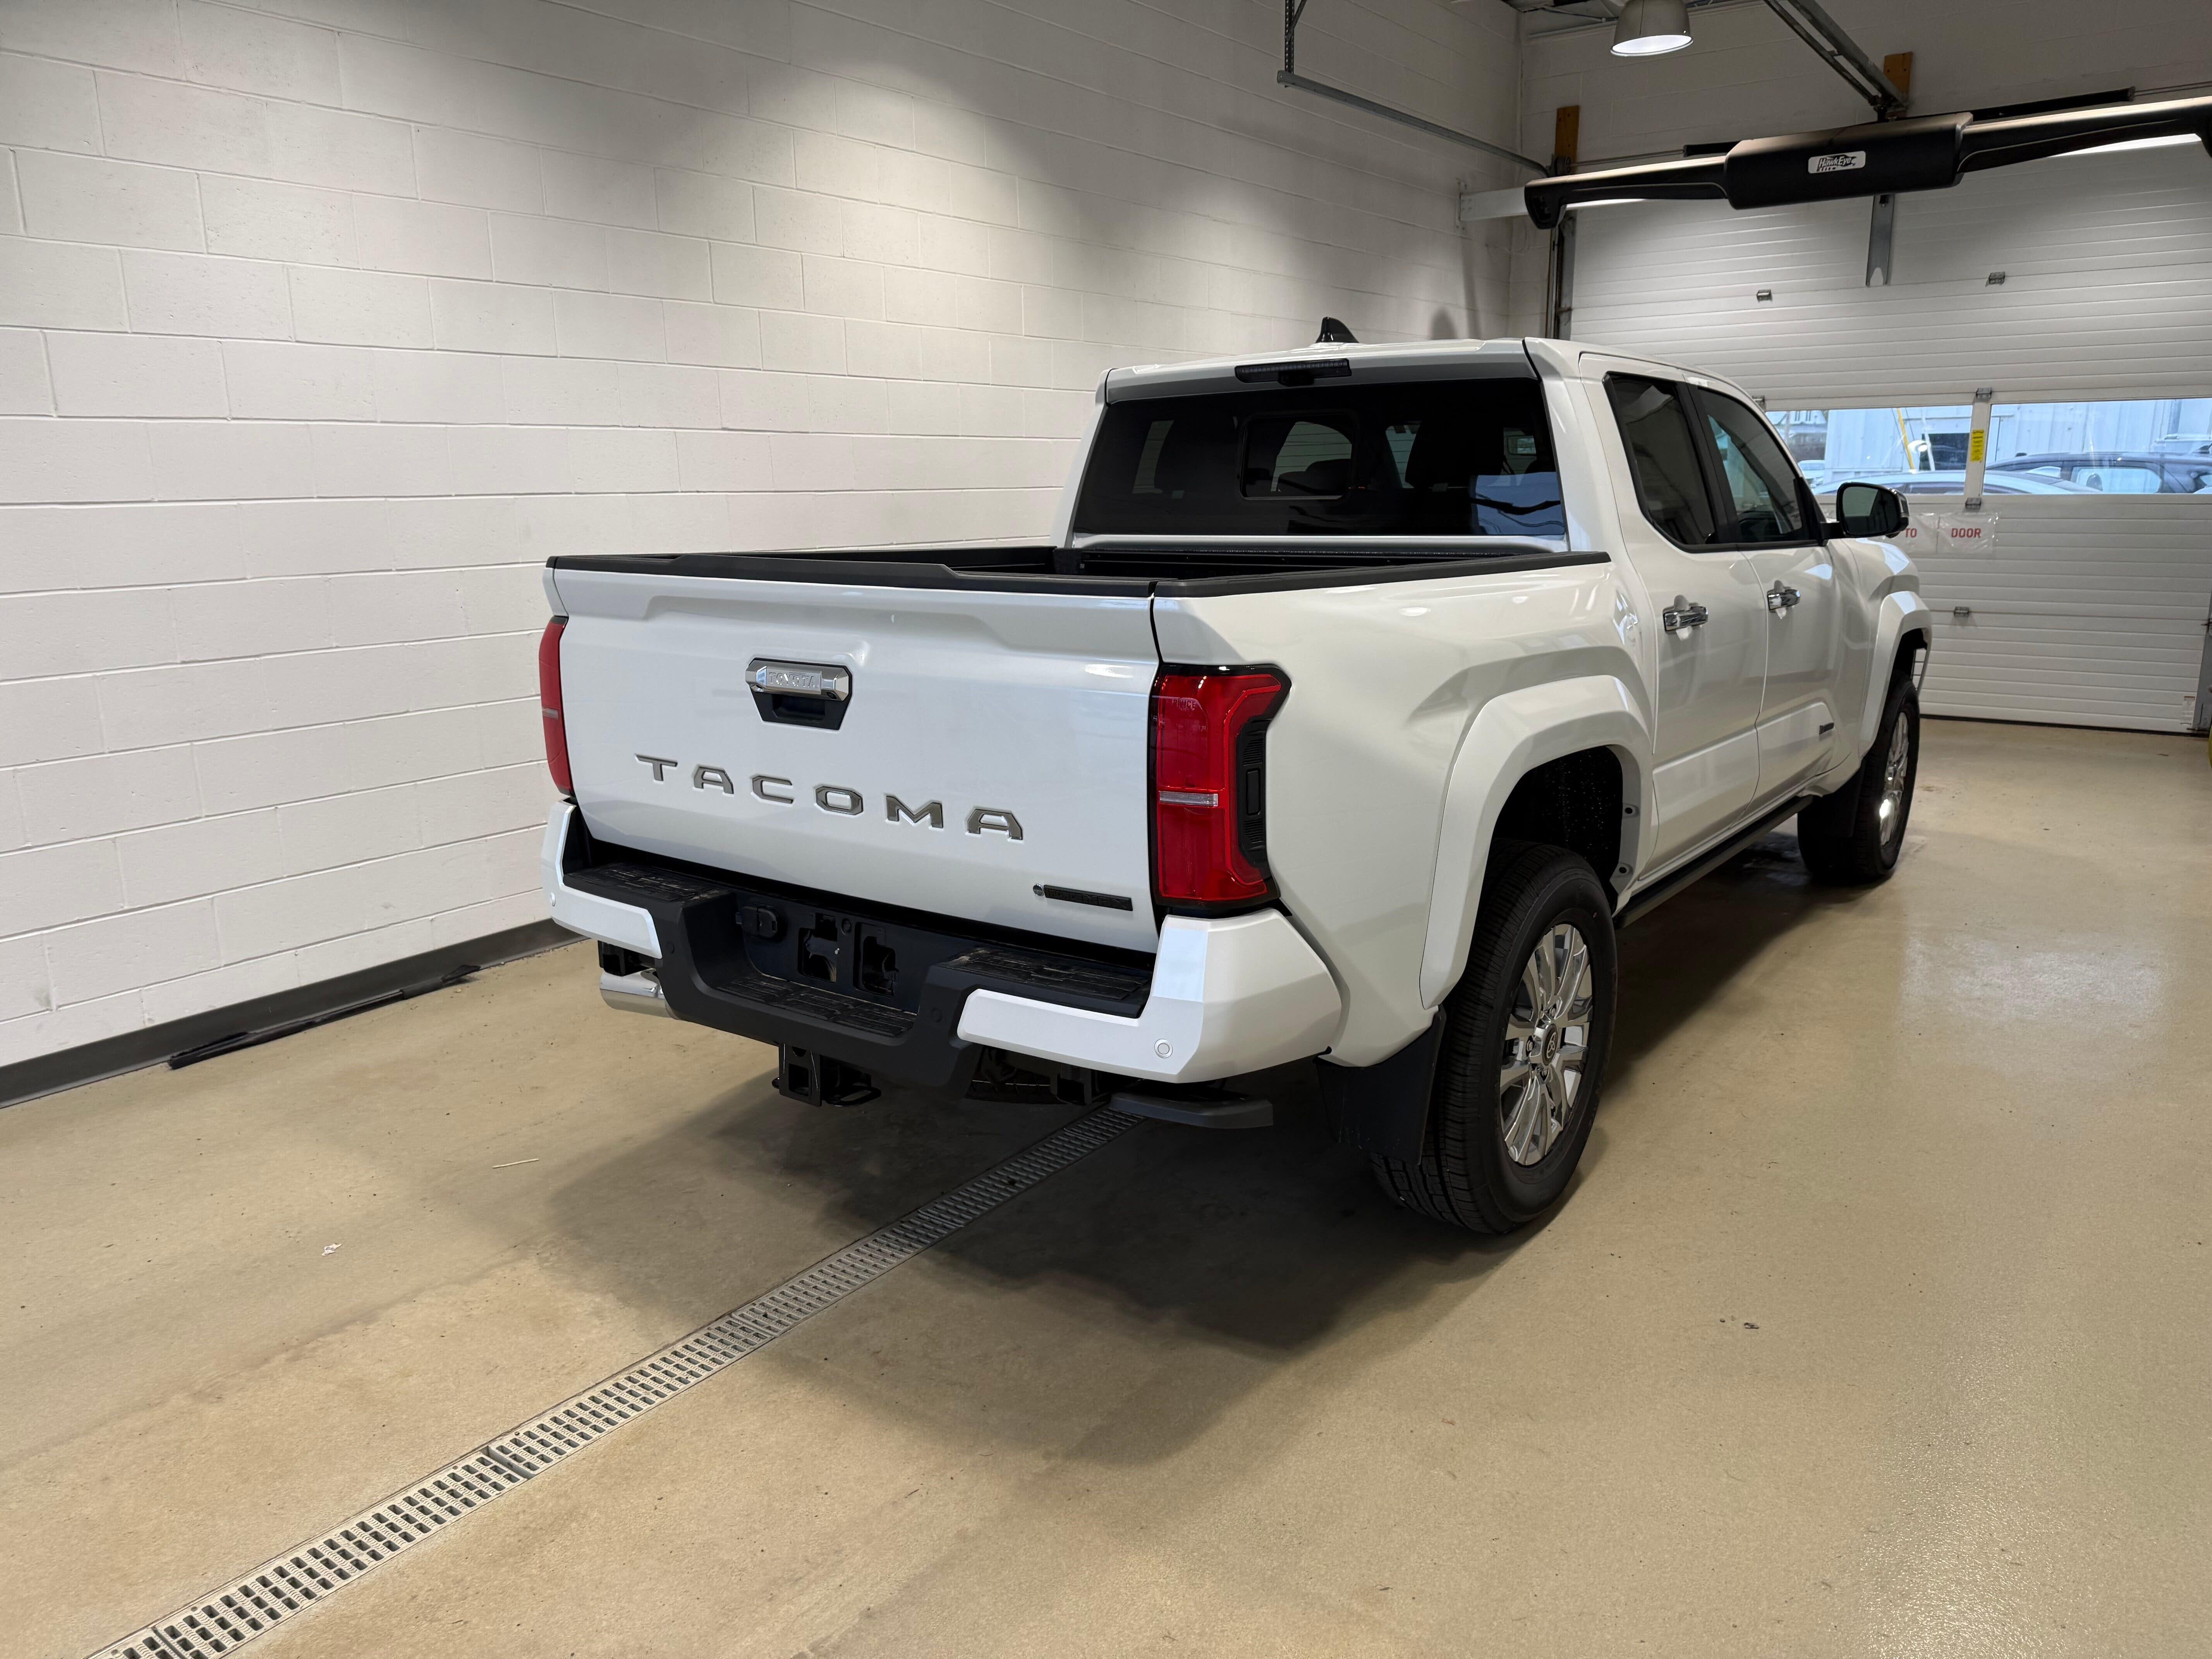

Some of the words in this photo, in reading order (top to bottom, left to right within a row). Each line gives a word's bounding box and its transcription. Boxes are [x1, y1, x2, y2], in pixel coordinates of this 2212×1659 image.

[1819, 155, 1852, 167] HawkEye
[1906, 528, 1917, 538] TO
[1951, 528, 1982, 538] DOOR
[769, 672, 817, 688] TOYOTA
[635, 753, 1024, 842] TACOMA
